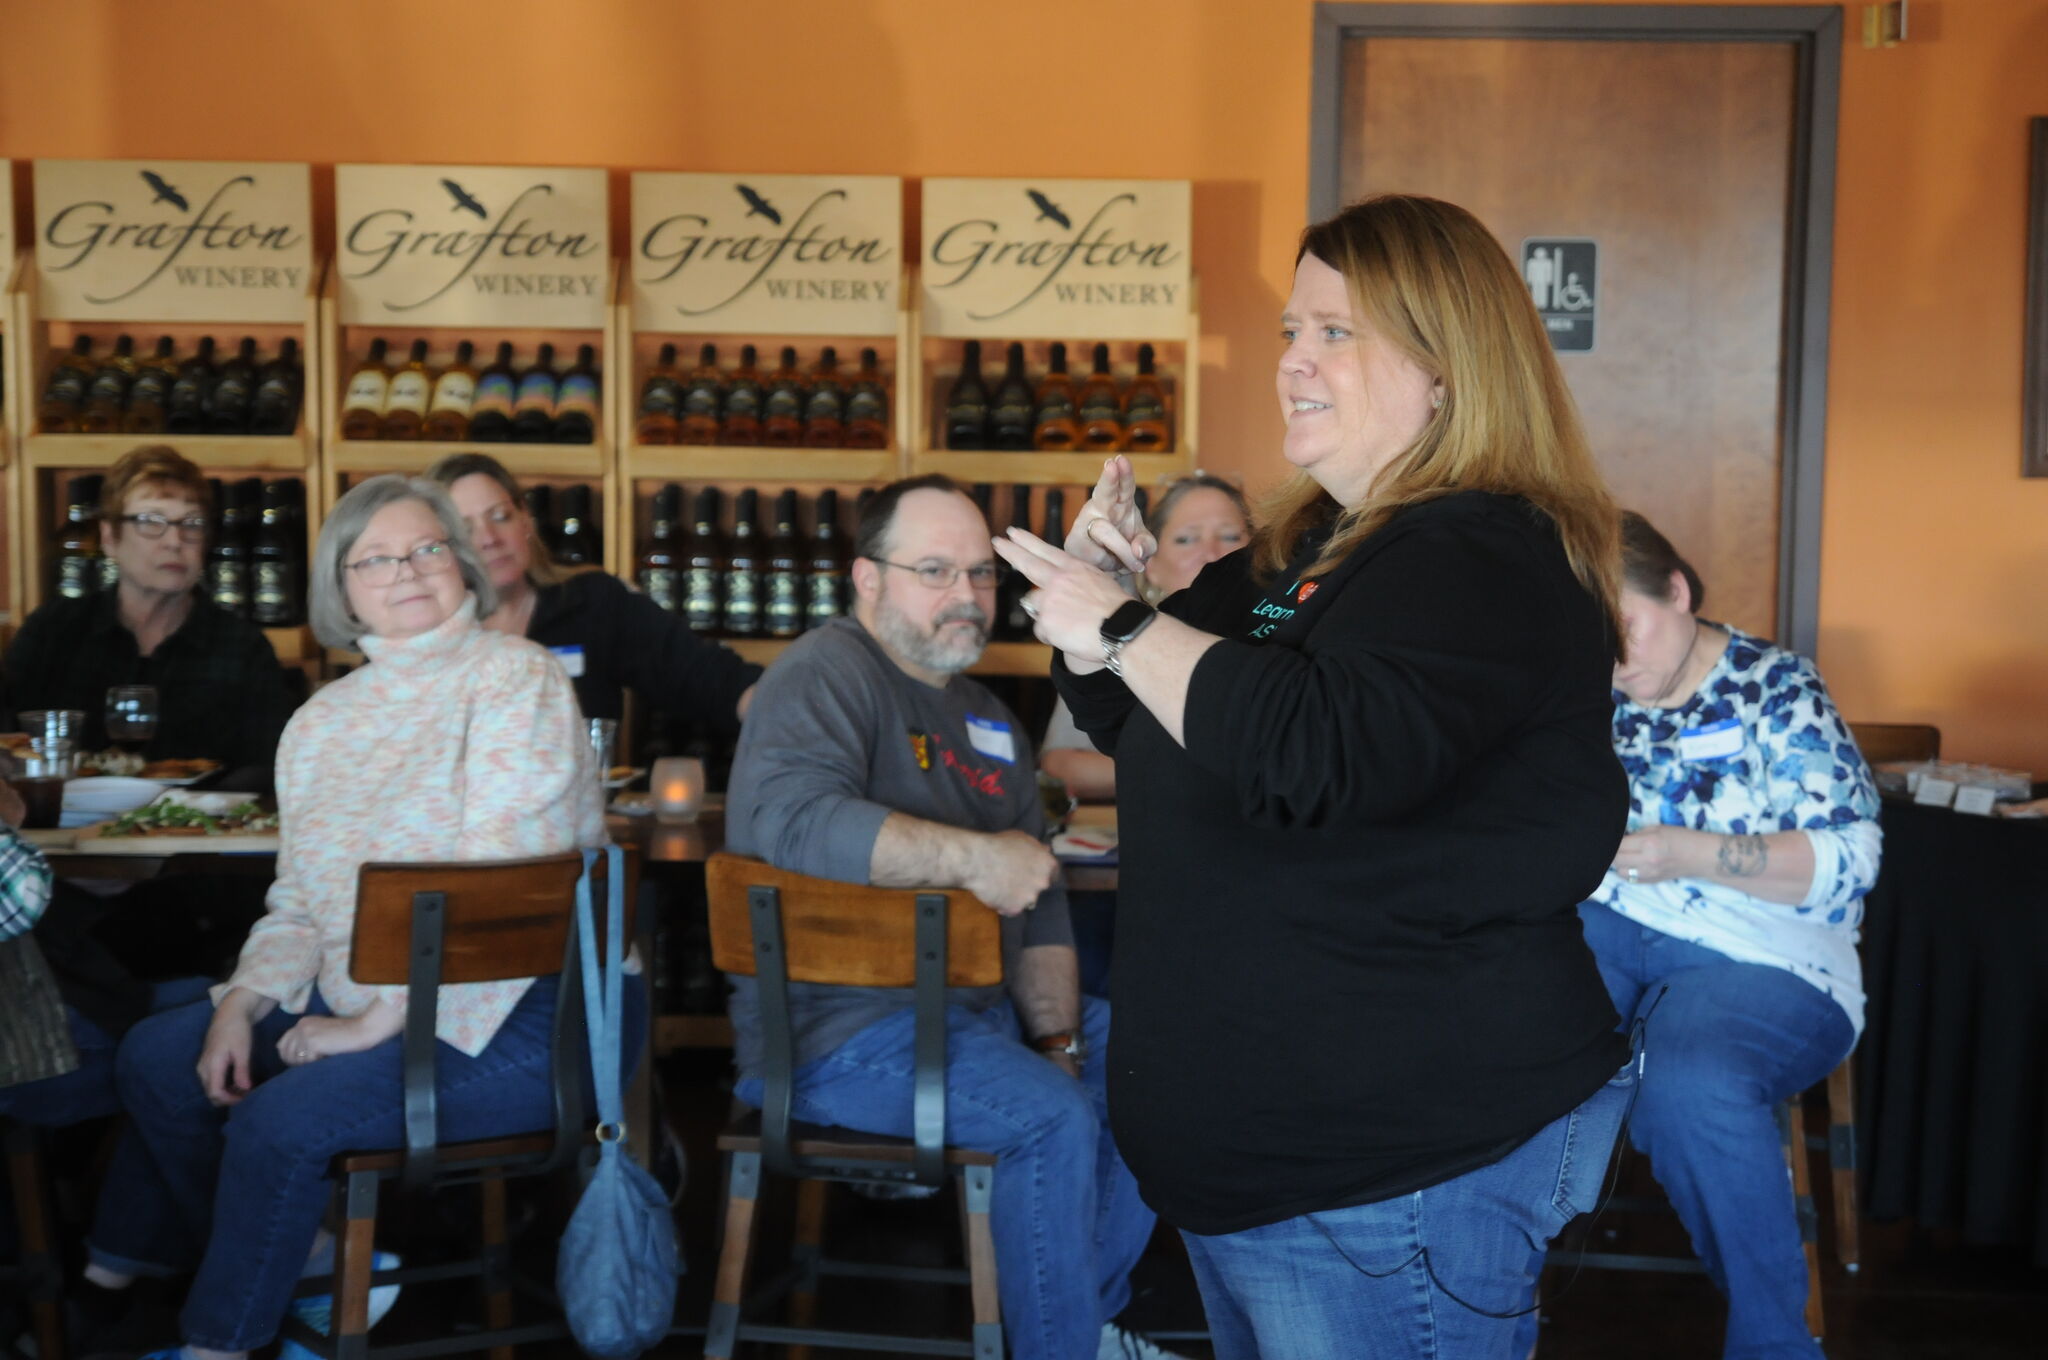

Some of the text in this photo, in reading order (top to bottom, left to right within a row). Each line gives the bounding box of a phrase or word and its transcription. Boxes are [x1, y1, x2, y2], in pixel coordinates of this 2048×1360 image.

[45, 175, 303, 305] Grafton
[344, 183, 600, 312] Grafton
[639, 189, 892, 317] Grafton
[930, 193, 1182, 321] Grafton
[174, 265, 301, 289] WINERY
[472, 273, 598, 297] WINERY
[766, 279, 890, 301] WINERY
[1055, 283, 1179, 306] WINERY
[1252, 598, 1295, 620] Learn
[1247, 623, 1278, 638] AS
